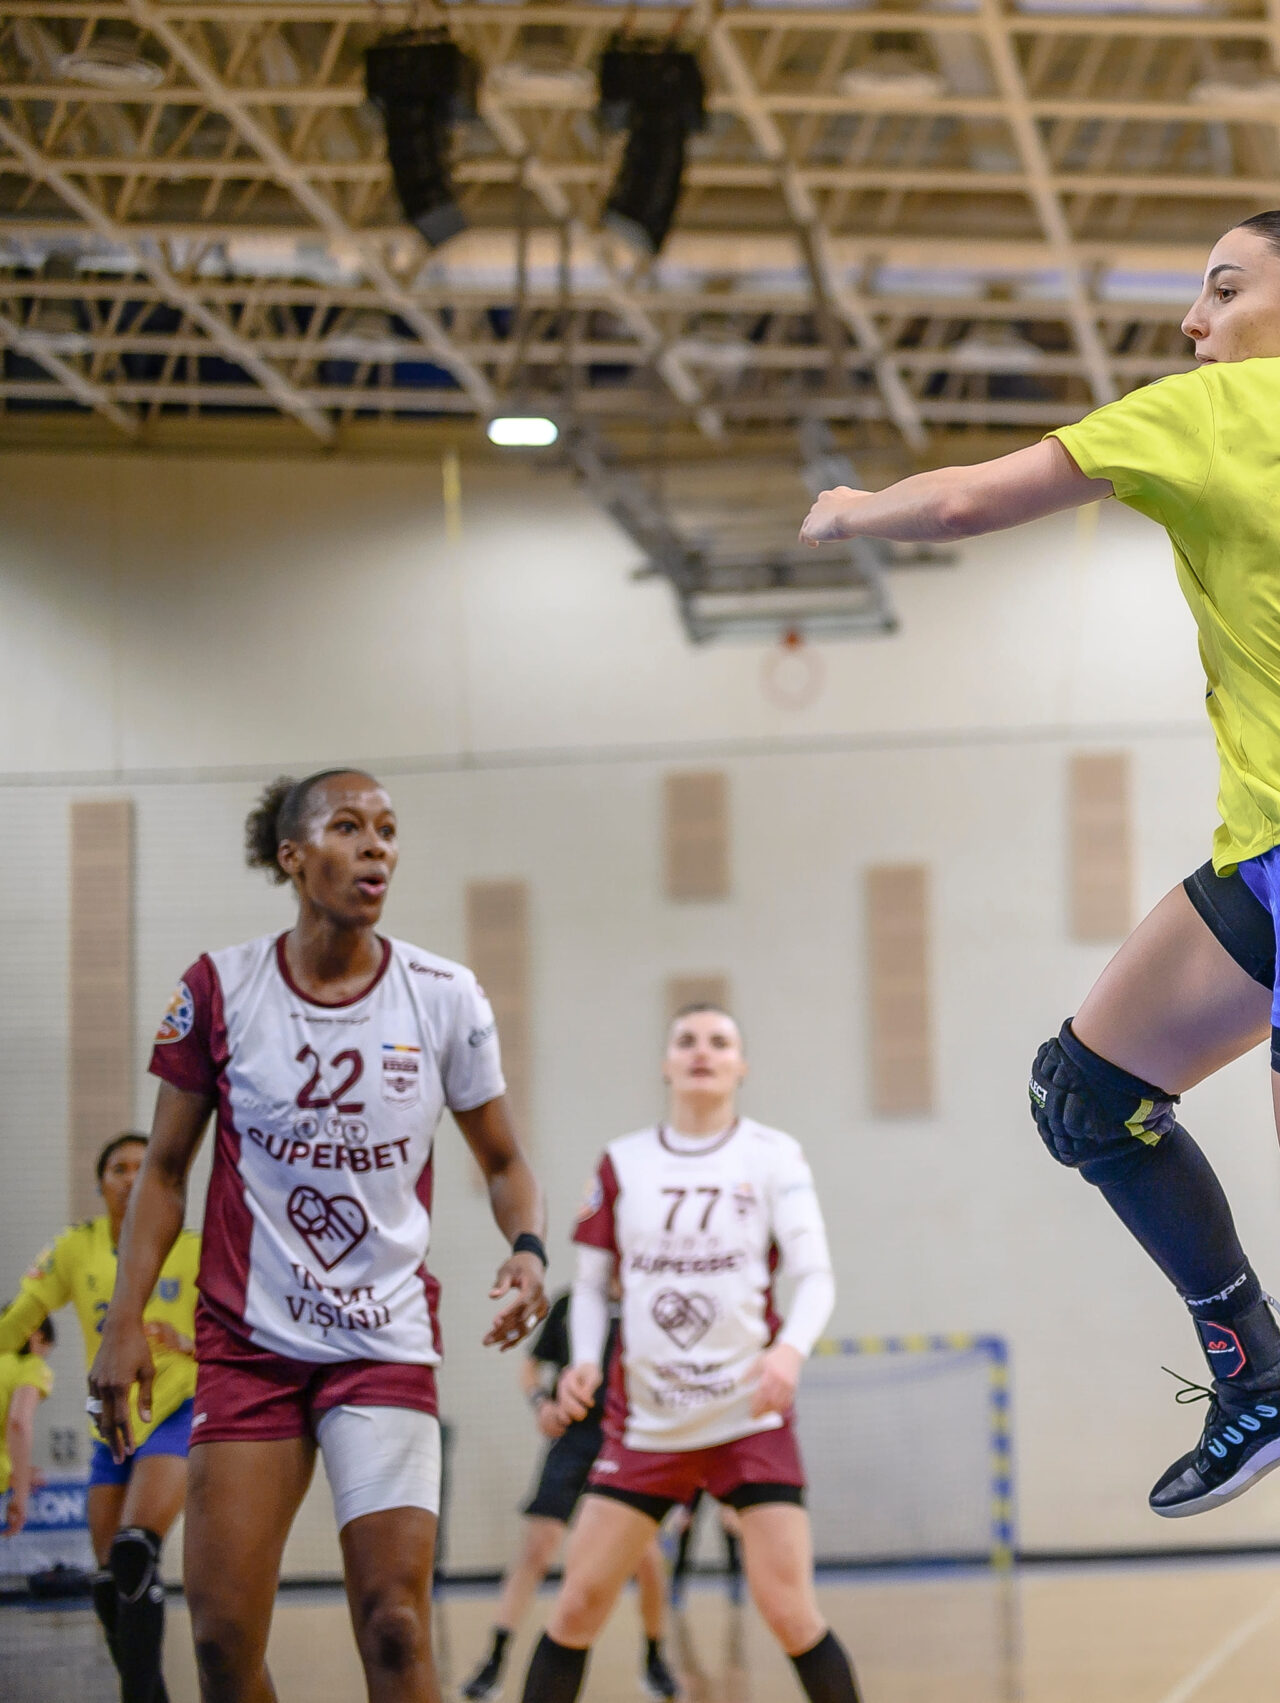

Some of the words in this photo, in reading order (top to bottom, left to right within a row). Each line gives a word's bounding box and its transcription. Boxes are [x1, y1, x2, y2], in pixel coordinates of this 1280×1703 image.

[296, 1044, 364, 1114] 22
[247, 1127, 411, 1173] SUPERBET
[661, 1187, 720, 1231] 77
[1183, 1273, 1247, 1306] empa
